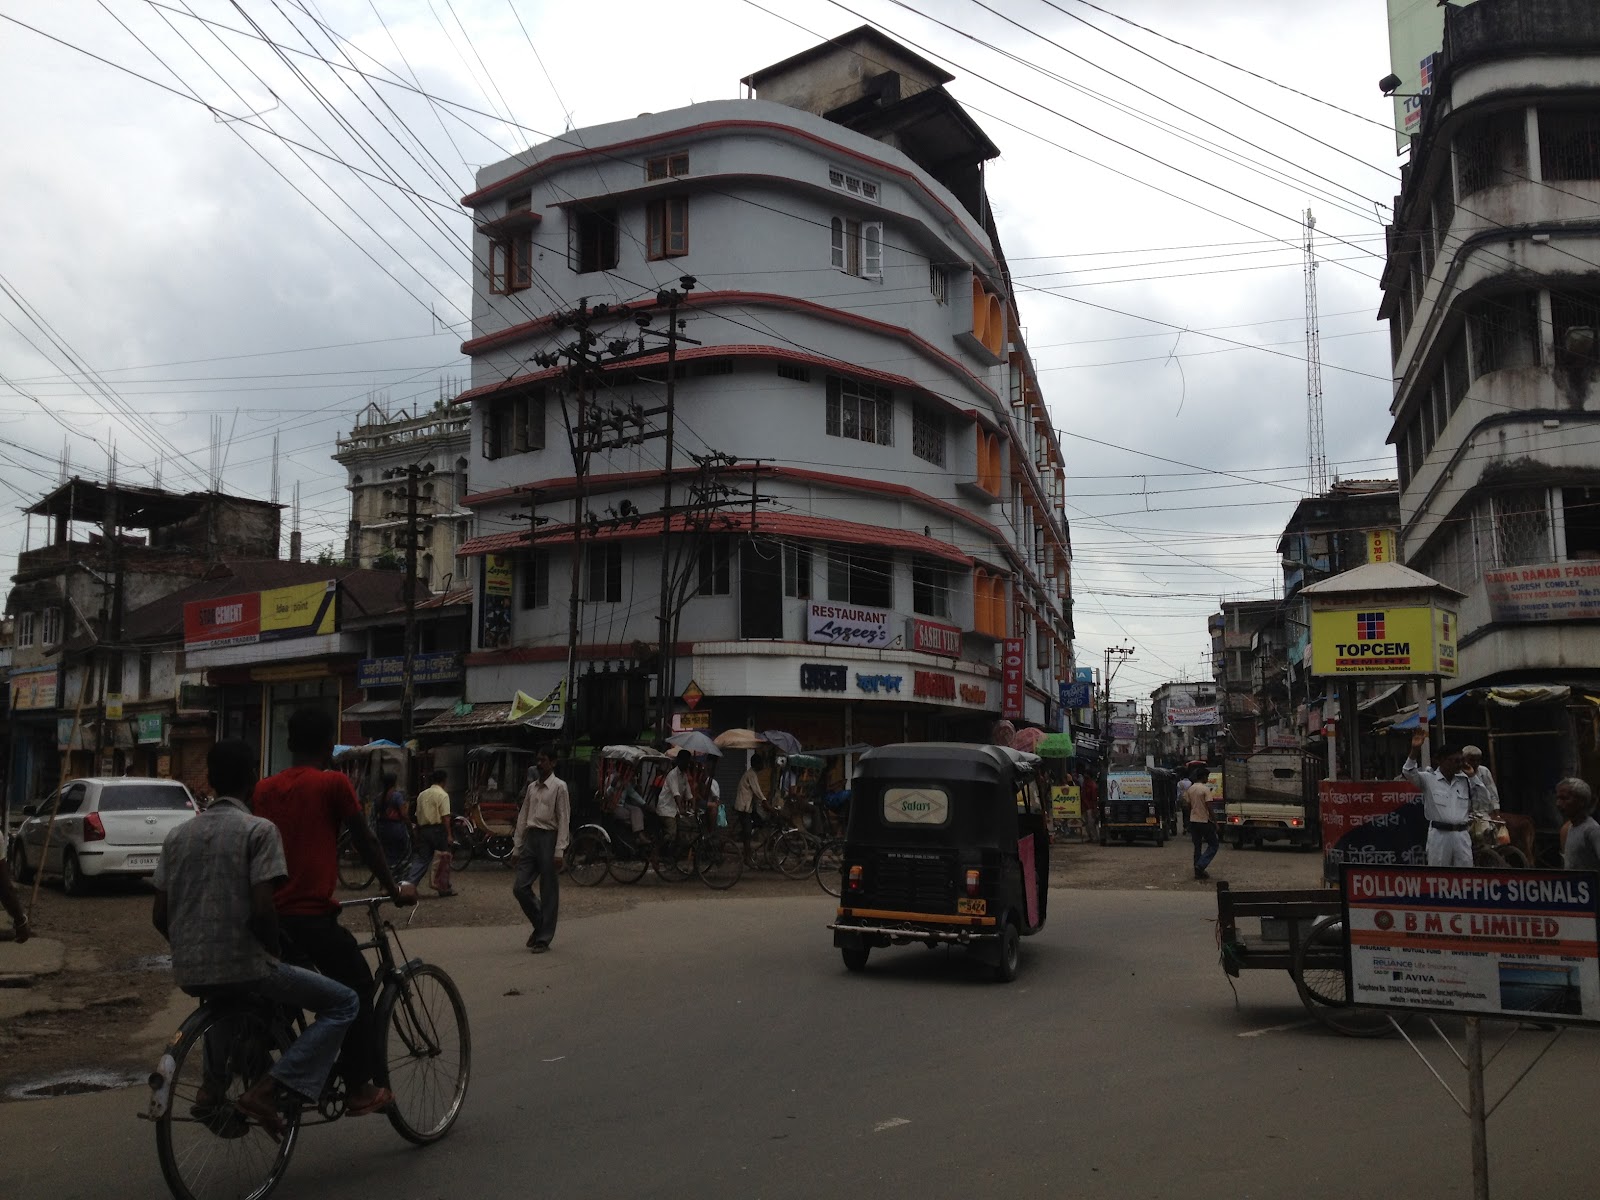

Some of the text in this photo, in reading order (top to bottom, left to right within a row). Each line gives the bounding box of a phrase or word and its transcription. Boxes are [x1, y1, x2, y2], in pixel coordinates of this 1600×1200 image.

[1486, 571, 1519, 584] RADHA
[1523, 568, 1560, 581] RAMAN
[1510, 583, 1541, 591] SURESH
[812, 605, 887, 624] RESTAURANT
[814, 621, 886, 643] Lazeez's
[919, 624, 960, 652] SASHI VIEW
[232, 636, 257, 645] TRADERS
[1336, 642, 1410, 657] TOPCEM
[1006, 642, 1021, 709] HOTEL
[901, 801, 931, 812] Safari
[1353, 875, 1591, 905] FOLLOW TRAFFIC SIGNALS
[1405, 912, 1560, 938] B M C LIMITED
[1529, 938, 1560, 946] LIMITED
[1405, 974, 1435, 983] AVIVA
